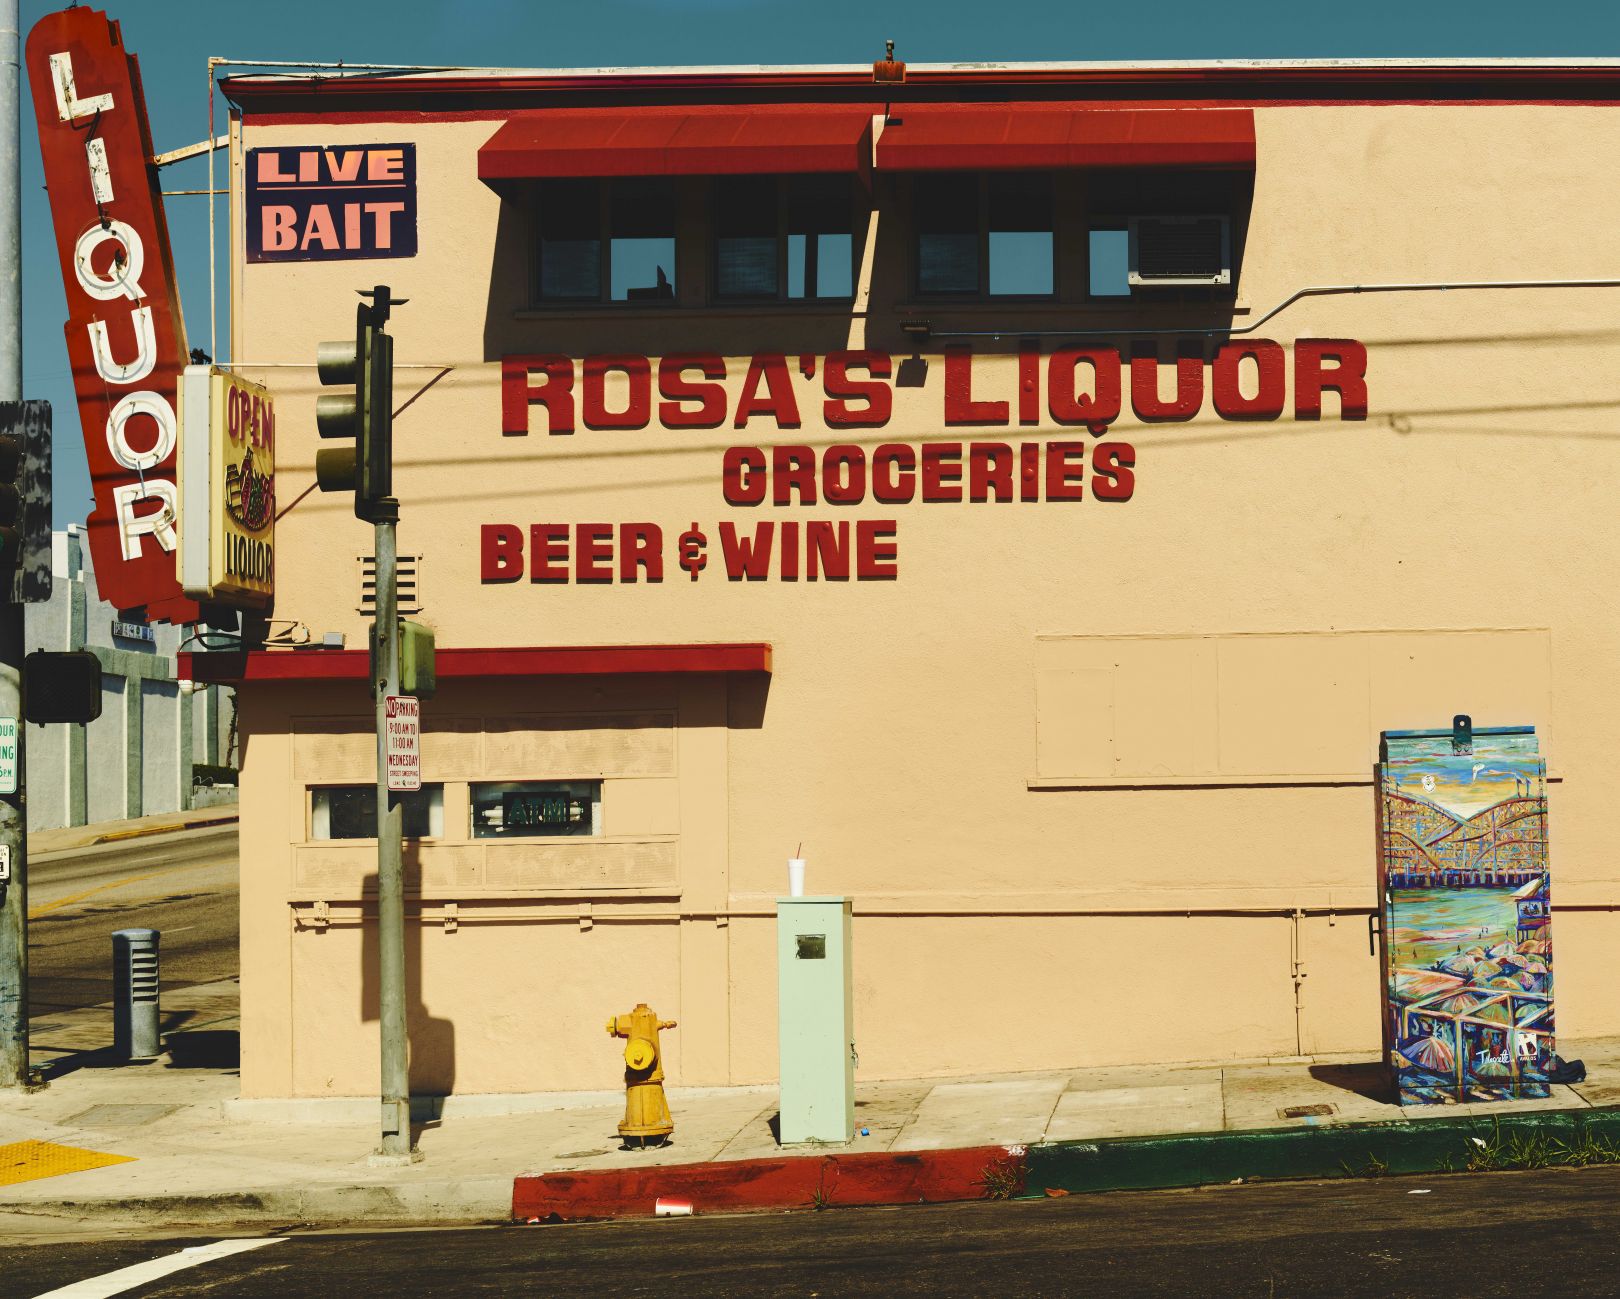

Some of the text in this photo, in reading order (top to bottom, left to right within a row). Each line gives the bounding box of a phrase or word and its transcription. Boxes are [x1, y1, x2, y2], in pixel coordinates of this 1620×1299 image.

[257, 150, 404, 183] LIVE
[261, 202, 405, 251] BAIT
[49, 52, 177, 561] LIQUOR
[501, 338, 1369, 437] ROSA'S LIQUOR
[227, 384, 274, 452] OPEN
[722, 441, 1137, 507] GROCERIES
[225, 531, 274, 586] LIQUOR
[480, 519, 898, 583] BEER & WINE
[386, 699, 418, 717] NO PARKING
[402, 723, 409, 735] AM
[388, 755, 418, 767] WEDNESDAY
[407, 737, 413, 749] AM
[510, 799, 566, 824] ATM
